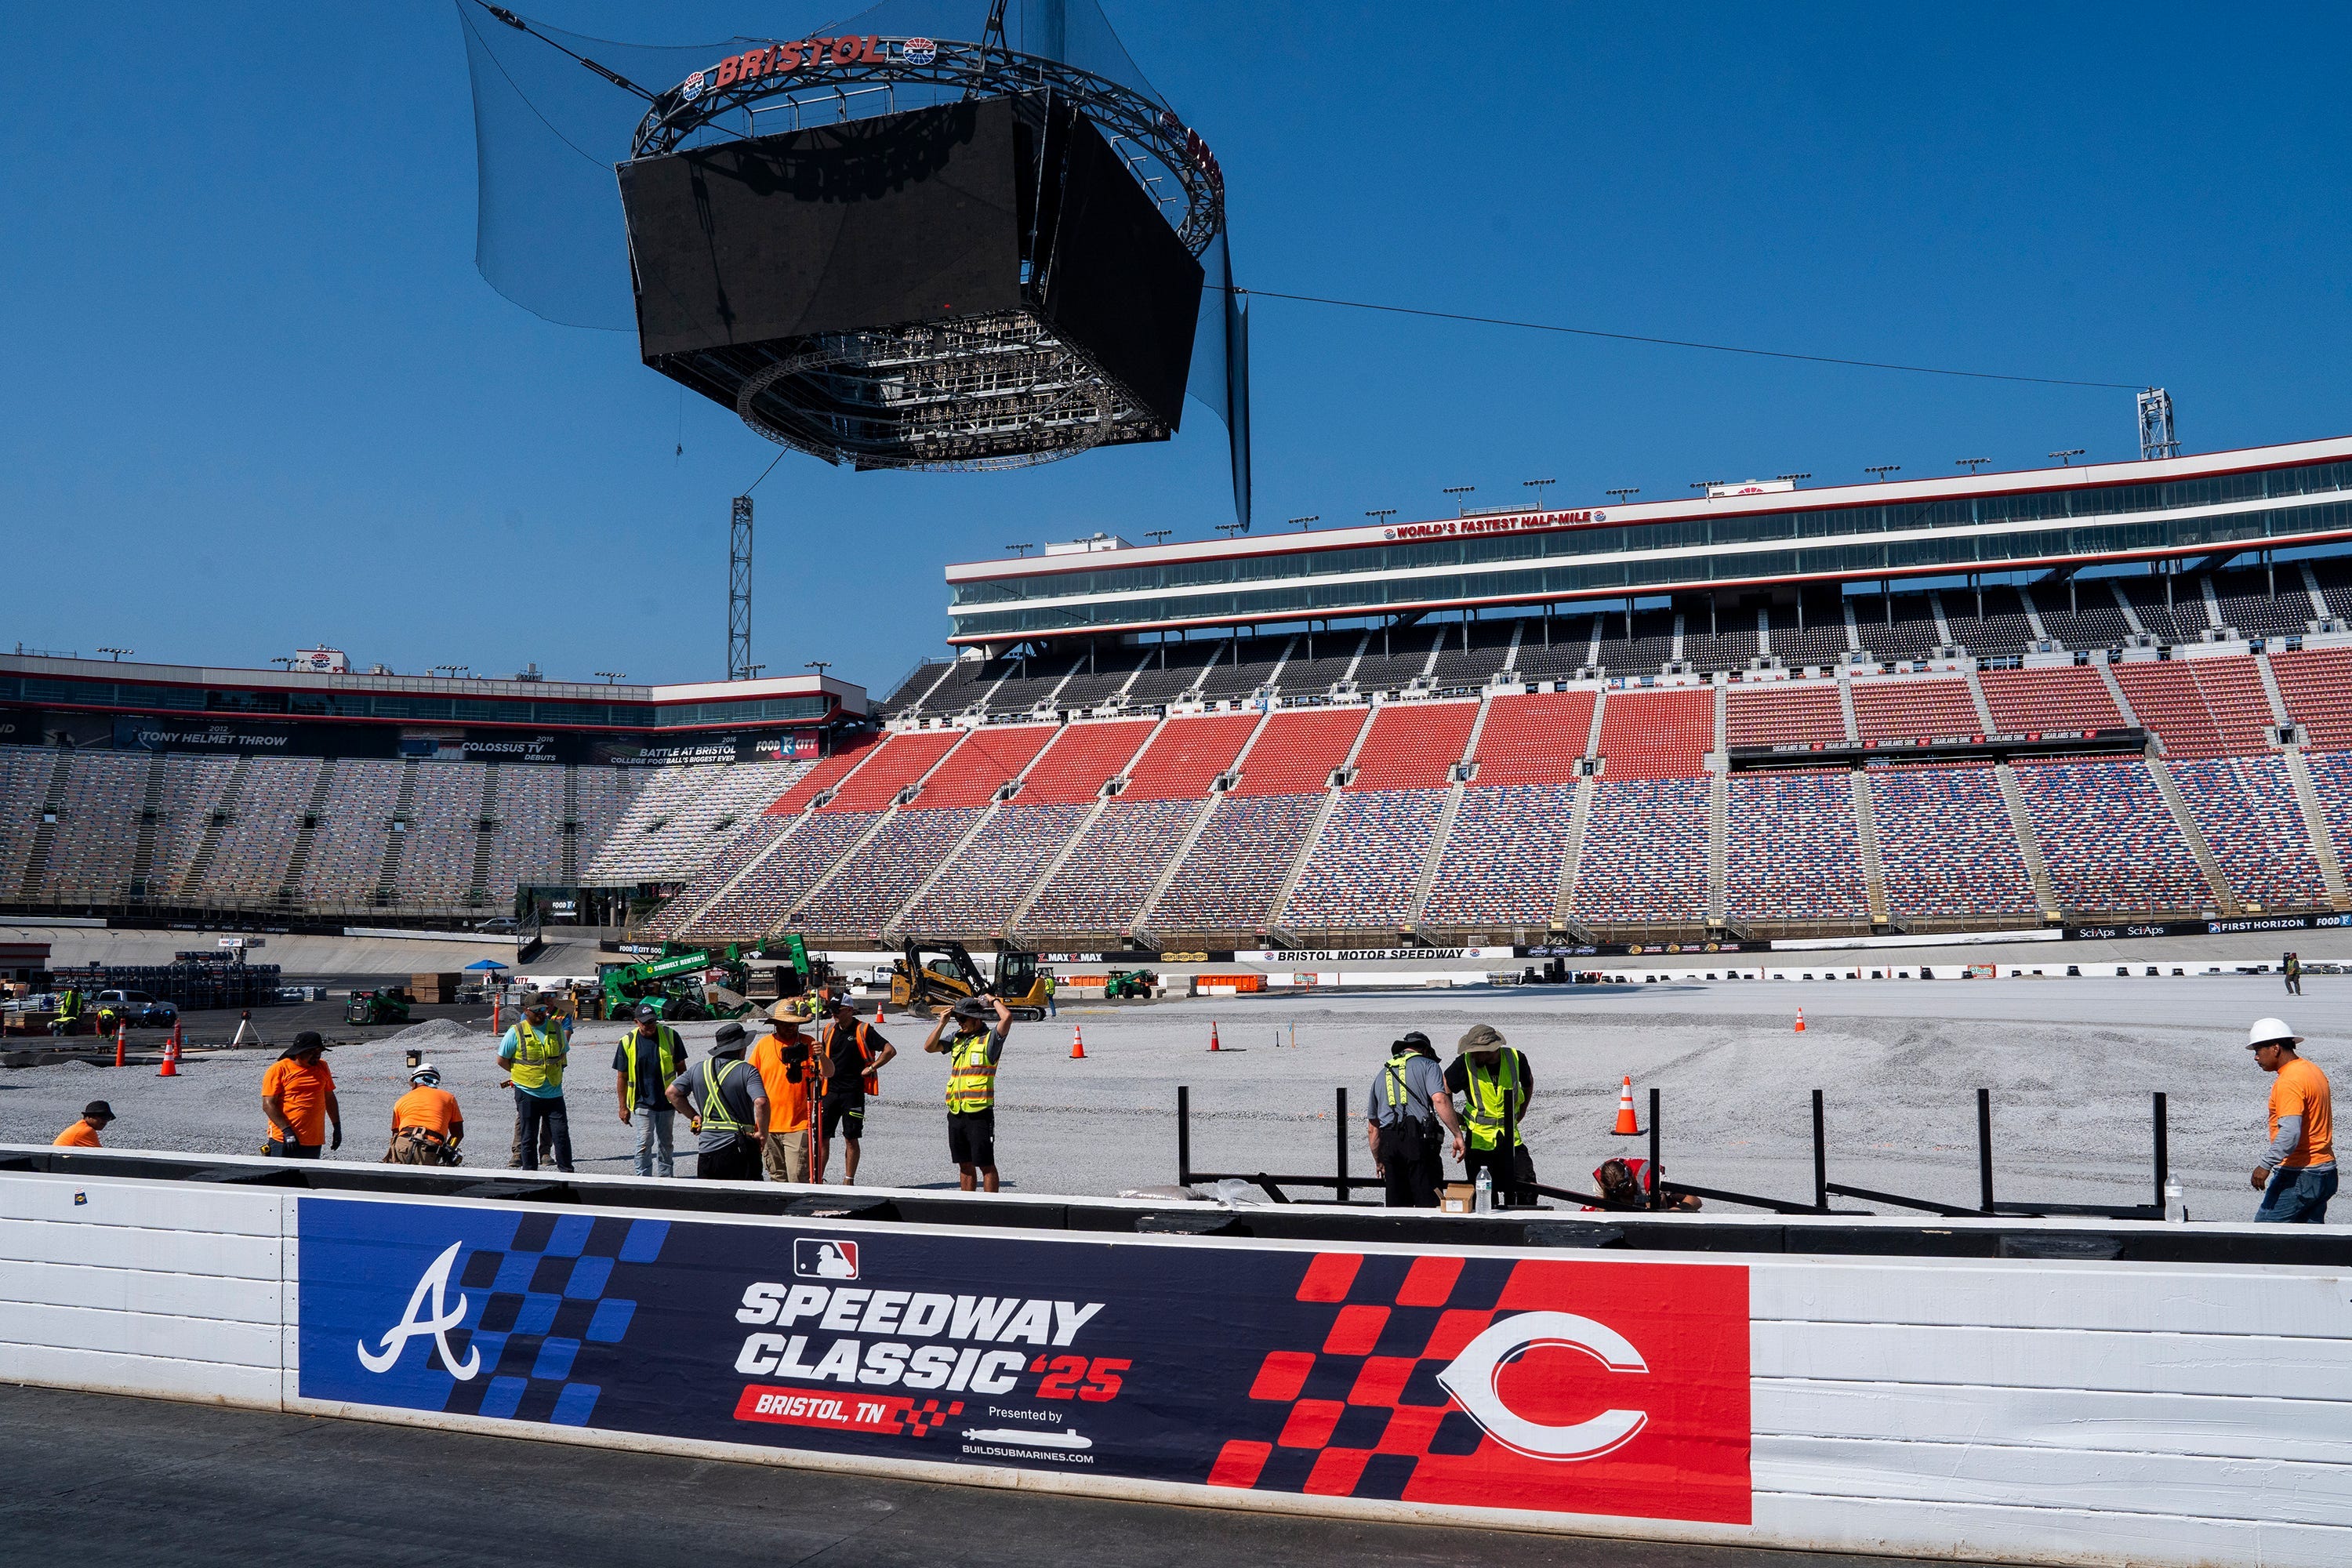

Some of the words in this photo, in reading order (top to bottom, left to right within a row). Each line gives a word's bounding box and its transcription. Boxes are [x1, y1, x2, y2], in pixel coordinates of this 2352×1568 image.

[715, 34, 886, 89] BRISTOL
[1396, 523, 1457, 539] WORLD'S
[1461, 517, 1519, 533] FASTEST
[1521, 511, 1592, 528] HALF-MILE
[143, 731, 180, 742] TONY
[182, 733, 236, 744] HELMET
[239, 735, 288, 746] THROW
[2042, 731, 2069, 740] SUGARLANDS
[462, 742, 525, 753] COLOSSUS
[528, 744, 544, 753] TV
[640, 748, 681, 758] BATTLE
[681, 746, 693, 757] AT
[695, 745, 736, 755] BRISTOL
[756, 740, 780, 752] FOOD
[795, 738, 816, 750] CITY
[647, 756, 689, 764] FOOTBALL'S
[2222, 922, 2252, 931] FIRST
[2316, 917, 2340, 926] FOOD
[653, 960, 679, 971] SUNBELT
[679, 954, 706, 966] RENTALS
[1277, 951, 1333, 961] BRISTOL
[1338, 950, 1386, 960] MOTOR
[1390, 949, 1465, 959] SPEEDWAY
[735, 1282, 1105, 1347] SPEEDWAY
[734, 1332, 1028, 1395] CLASSIC
[1029, 1353, 1133, 1402] '25
[754, 1392, 848, 1423] BRISTOL,
[856, 1402, 887, 1424] TN
[989, 1406, 1045, 1421] Presented
[1048, 1410, 1063, 1425] by
[962, 1444, 1094, 1465] BUILDSUBMARINES.COM
